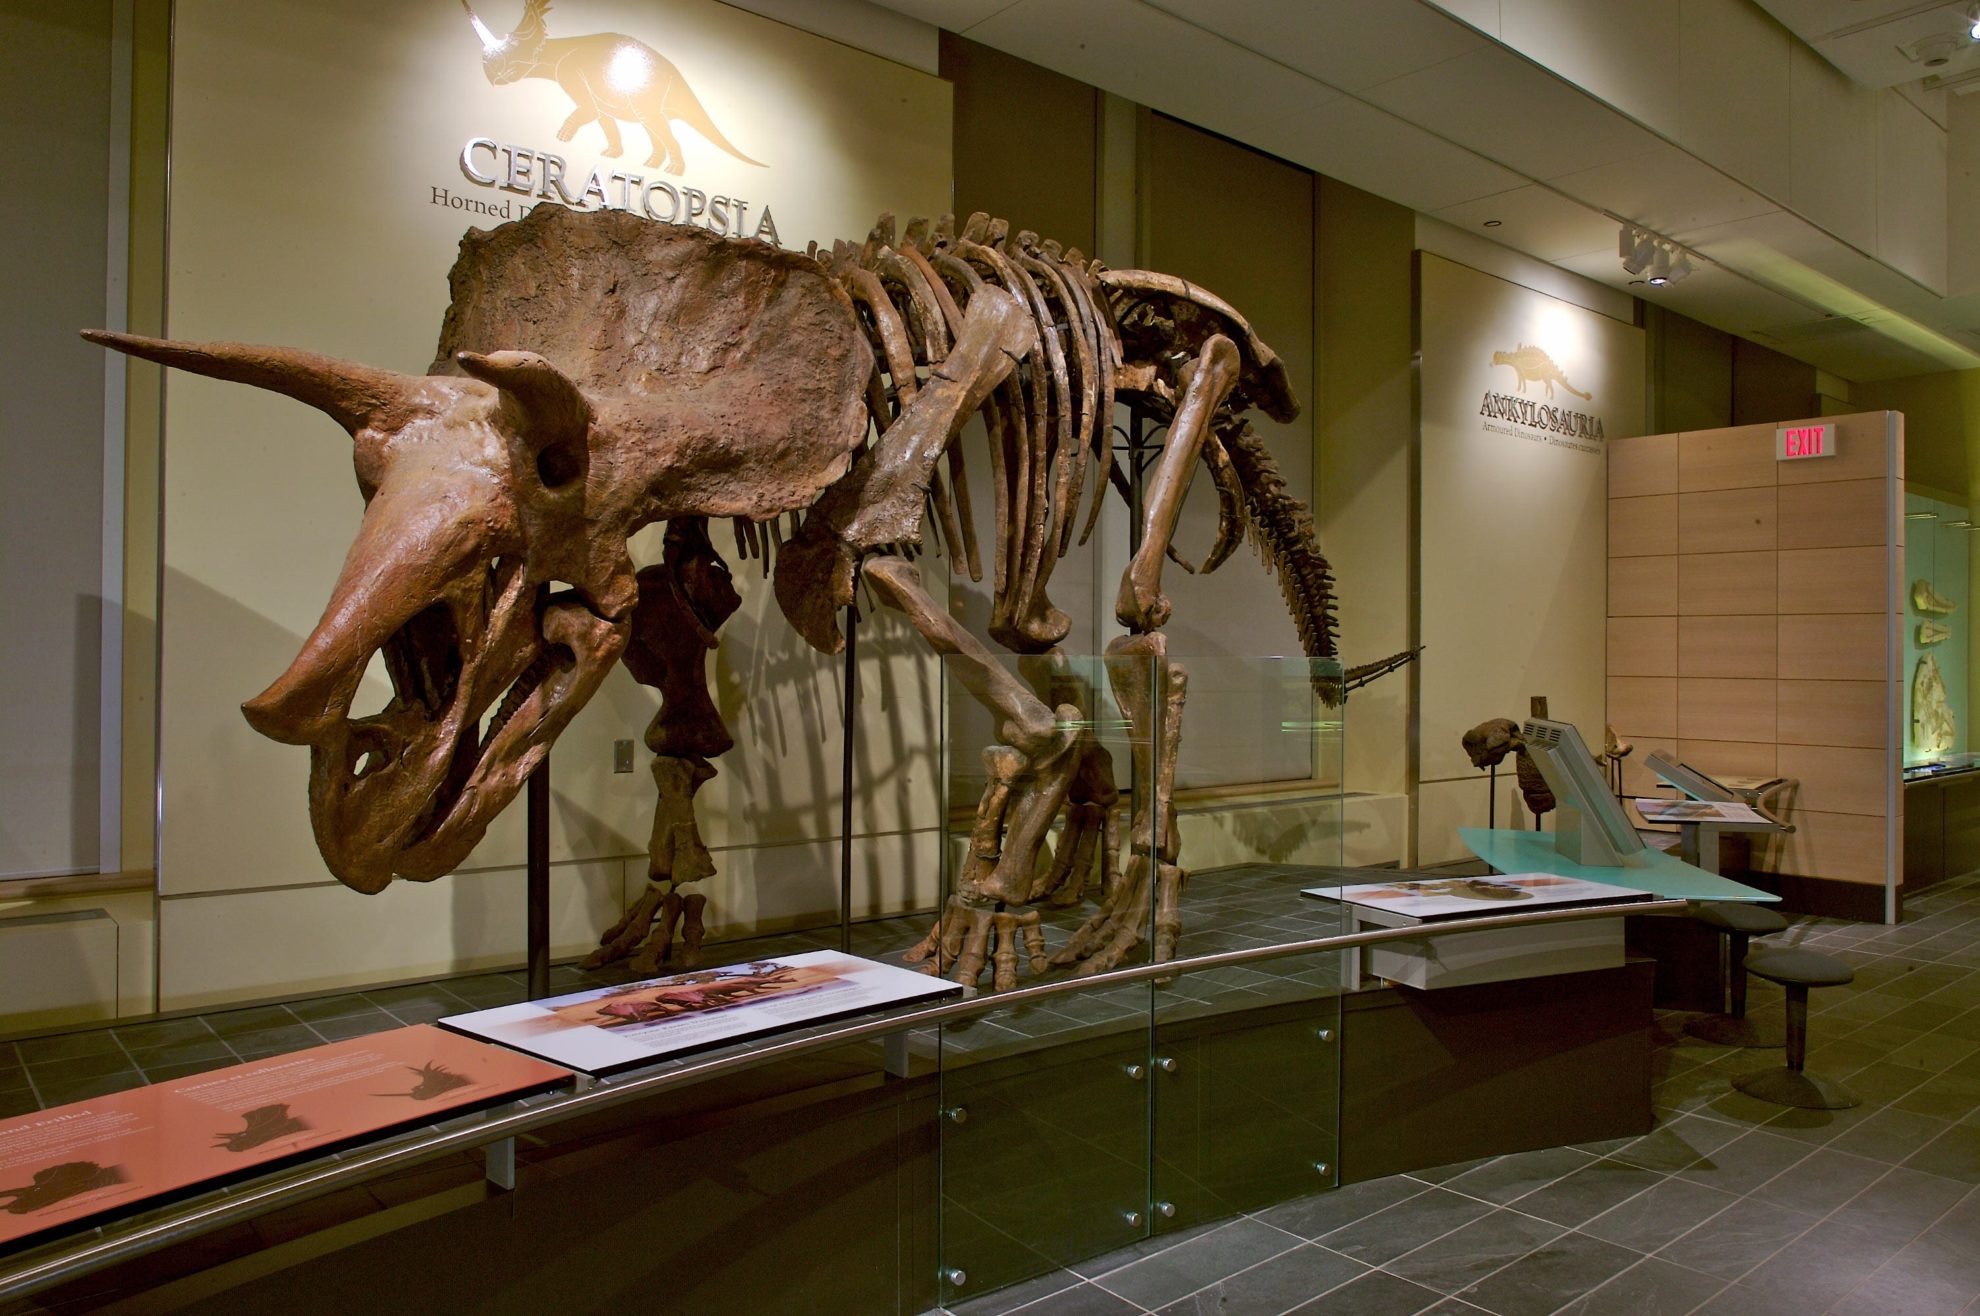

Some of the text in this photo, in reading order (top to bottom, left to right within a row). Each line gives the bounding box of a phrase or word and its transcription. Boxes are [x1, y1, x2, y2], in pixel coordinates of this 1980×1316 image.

[430, 186, 511, 220] Horned
[462, 137, 782, 247] CERATOPSIA
[1479, 390, 1605, 442] ANKYLOSAURIA
[1482, 420, 1513, 437] Armoured
[1786, 426, 1825, 457] EXIT
